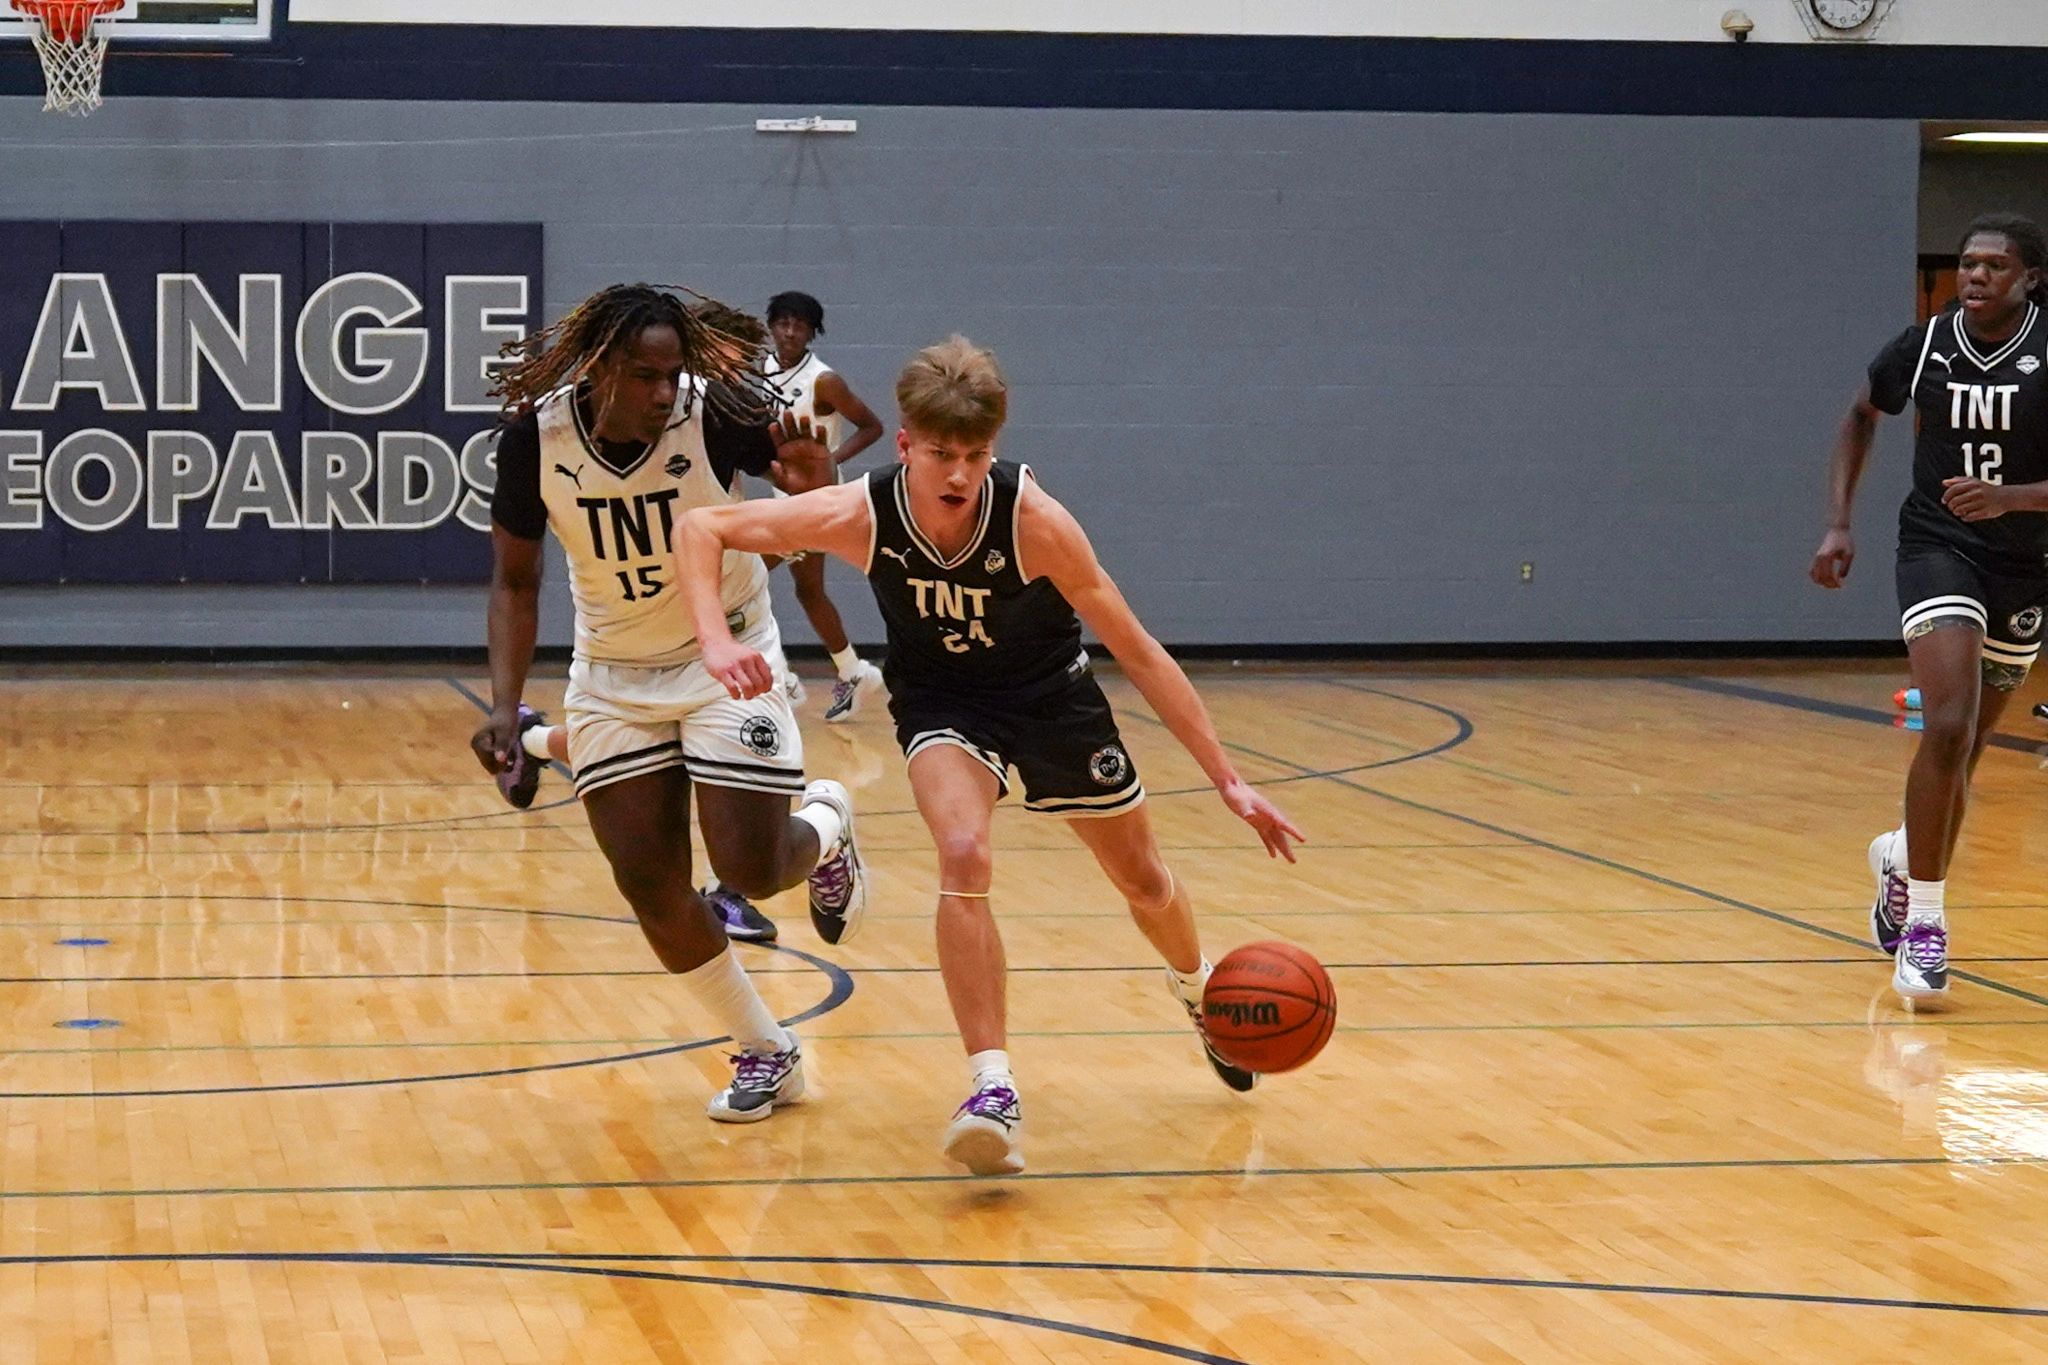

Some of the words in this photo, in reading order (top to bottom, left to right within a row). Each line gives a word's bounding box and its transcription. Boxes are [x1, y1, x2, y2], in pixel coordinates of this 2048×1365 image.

[11, 272, 528, 415] ANGE
[1946, 382, 2020, 430] TNT
[1961, 442, 2003, 486] 12
[576, 488, 679, 562] TNT
[616, 565, 663, 602] 15
[906, 577, 992, 621] TNT
[938, 619, 996, 654] 24
[1207, 1002, 1280, 1026] Wilson
